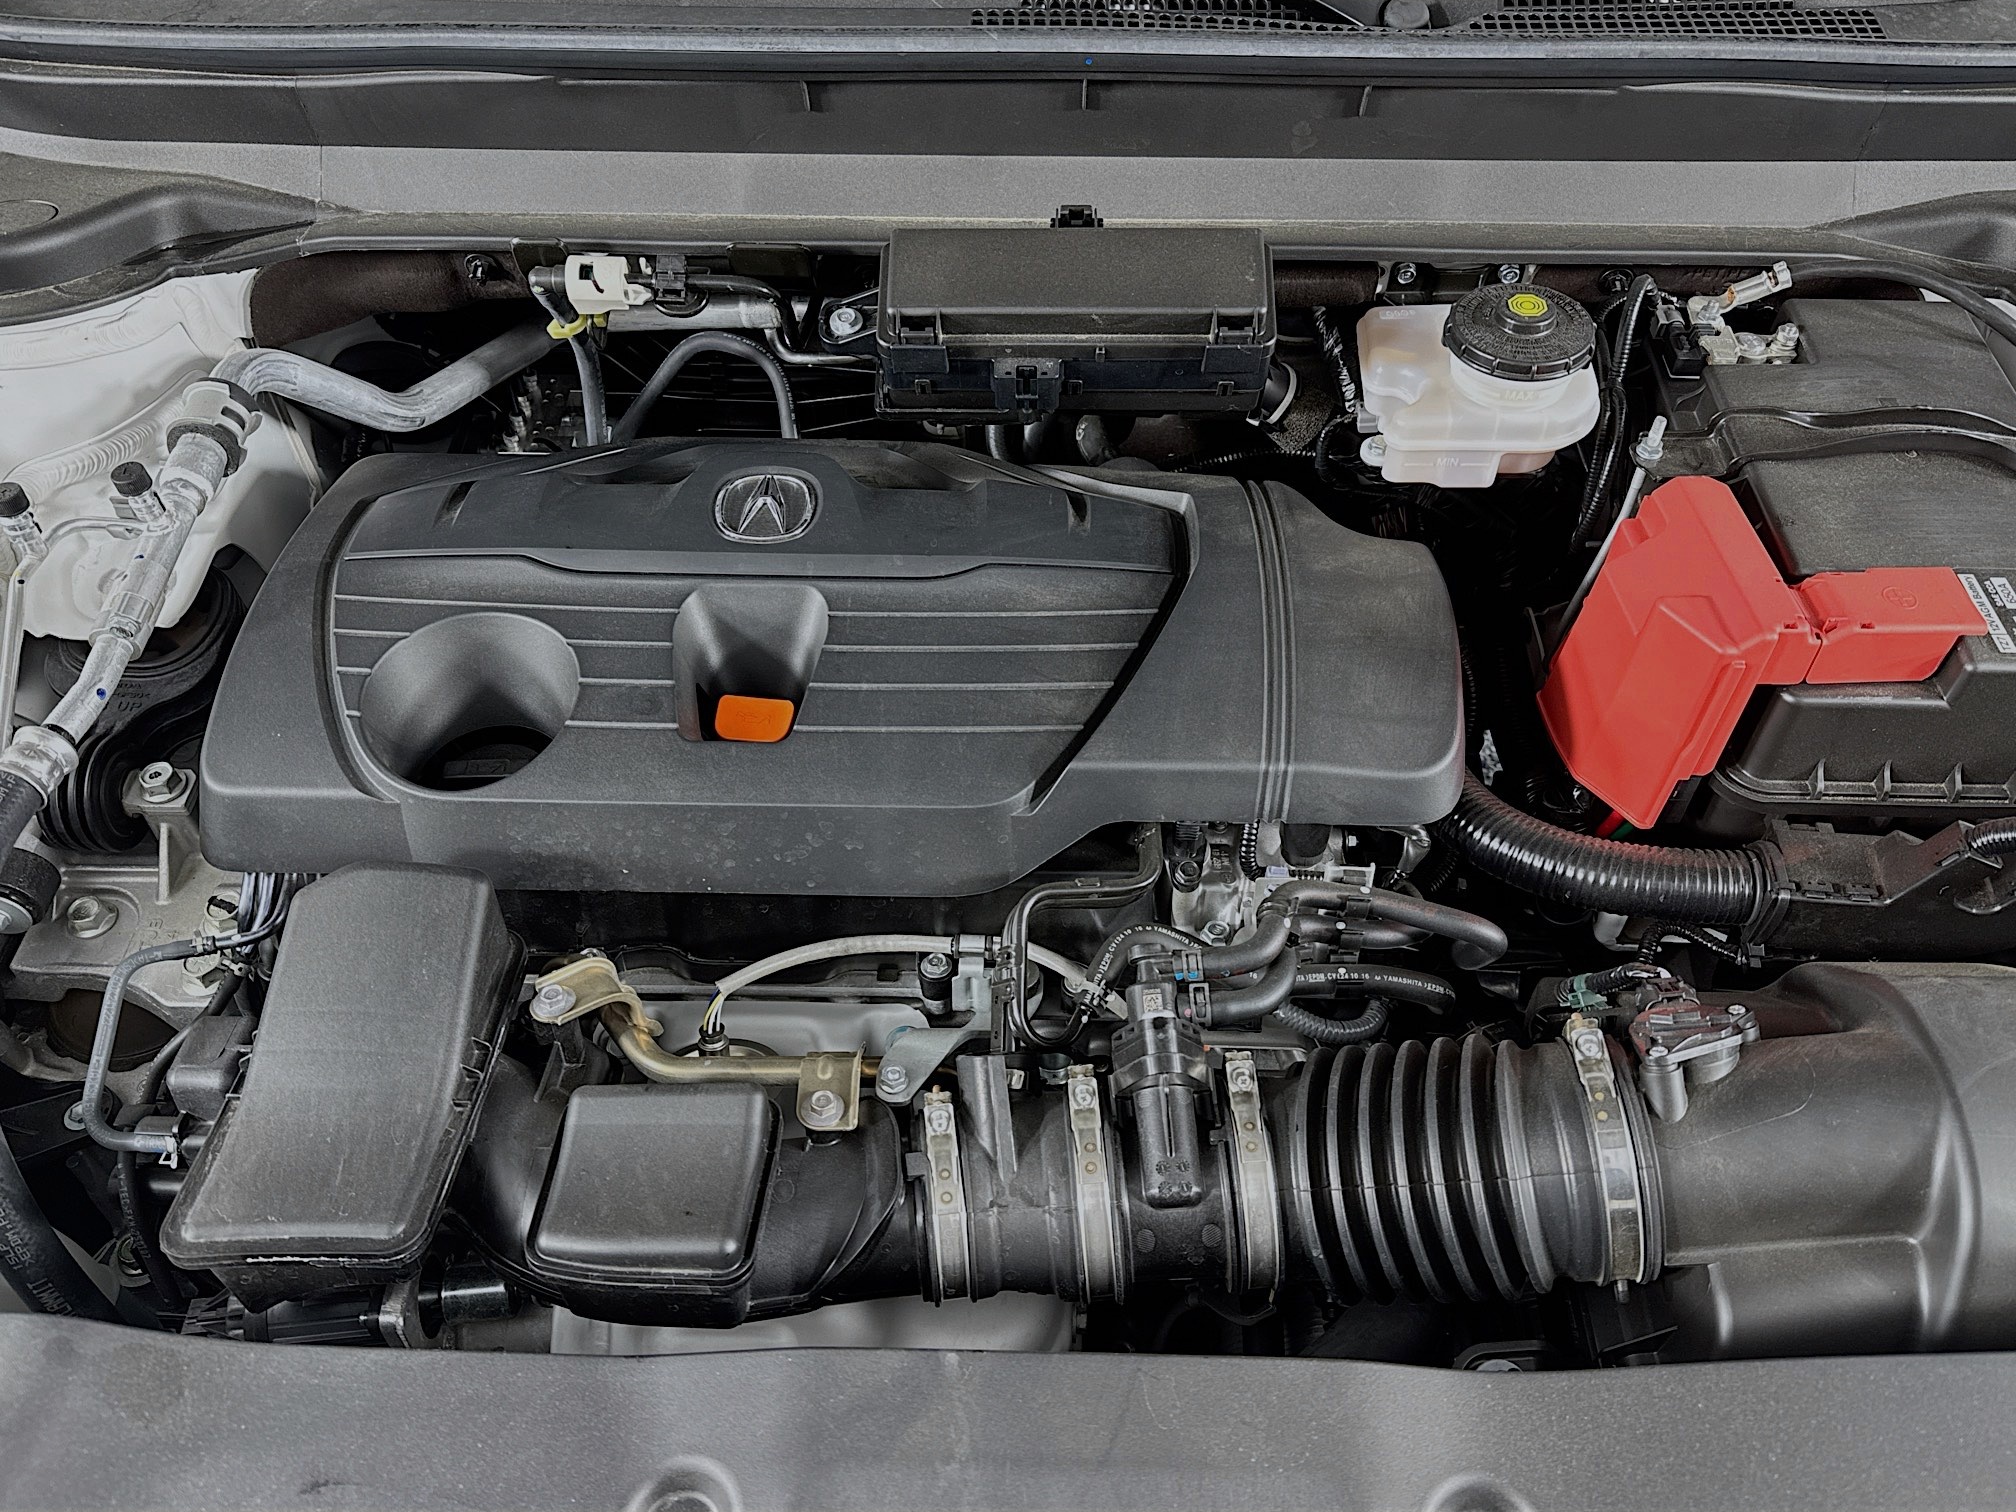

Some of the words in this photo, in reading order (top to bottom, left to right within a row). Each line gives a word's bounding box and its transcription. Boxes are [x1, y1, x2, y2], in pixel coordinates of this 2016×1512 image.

[1505, 390, 1534, 401] MAX
[1435, 457, 1459, 467] MIN
[1964, 575, 1982, 600] Battery
[1976, 601, 1994, 620] AGM
[1153, 925, 1190, 945] YAMASHITA
[1383, 975, 1423, 987] YAMASHITA
